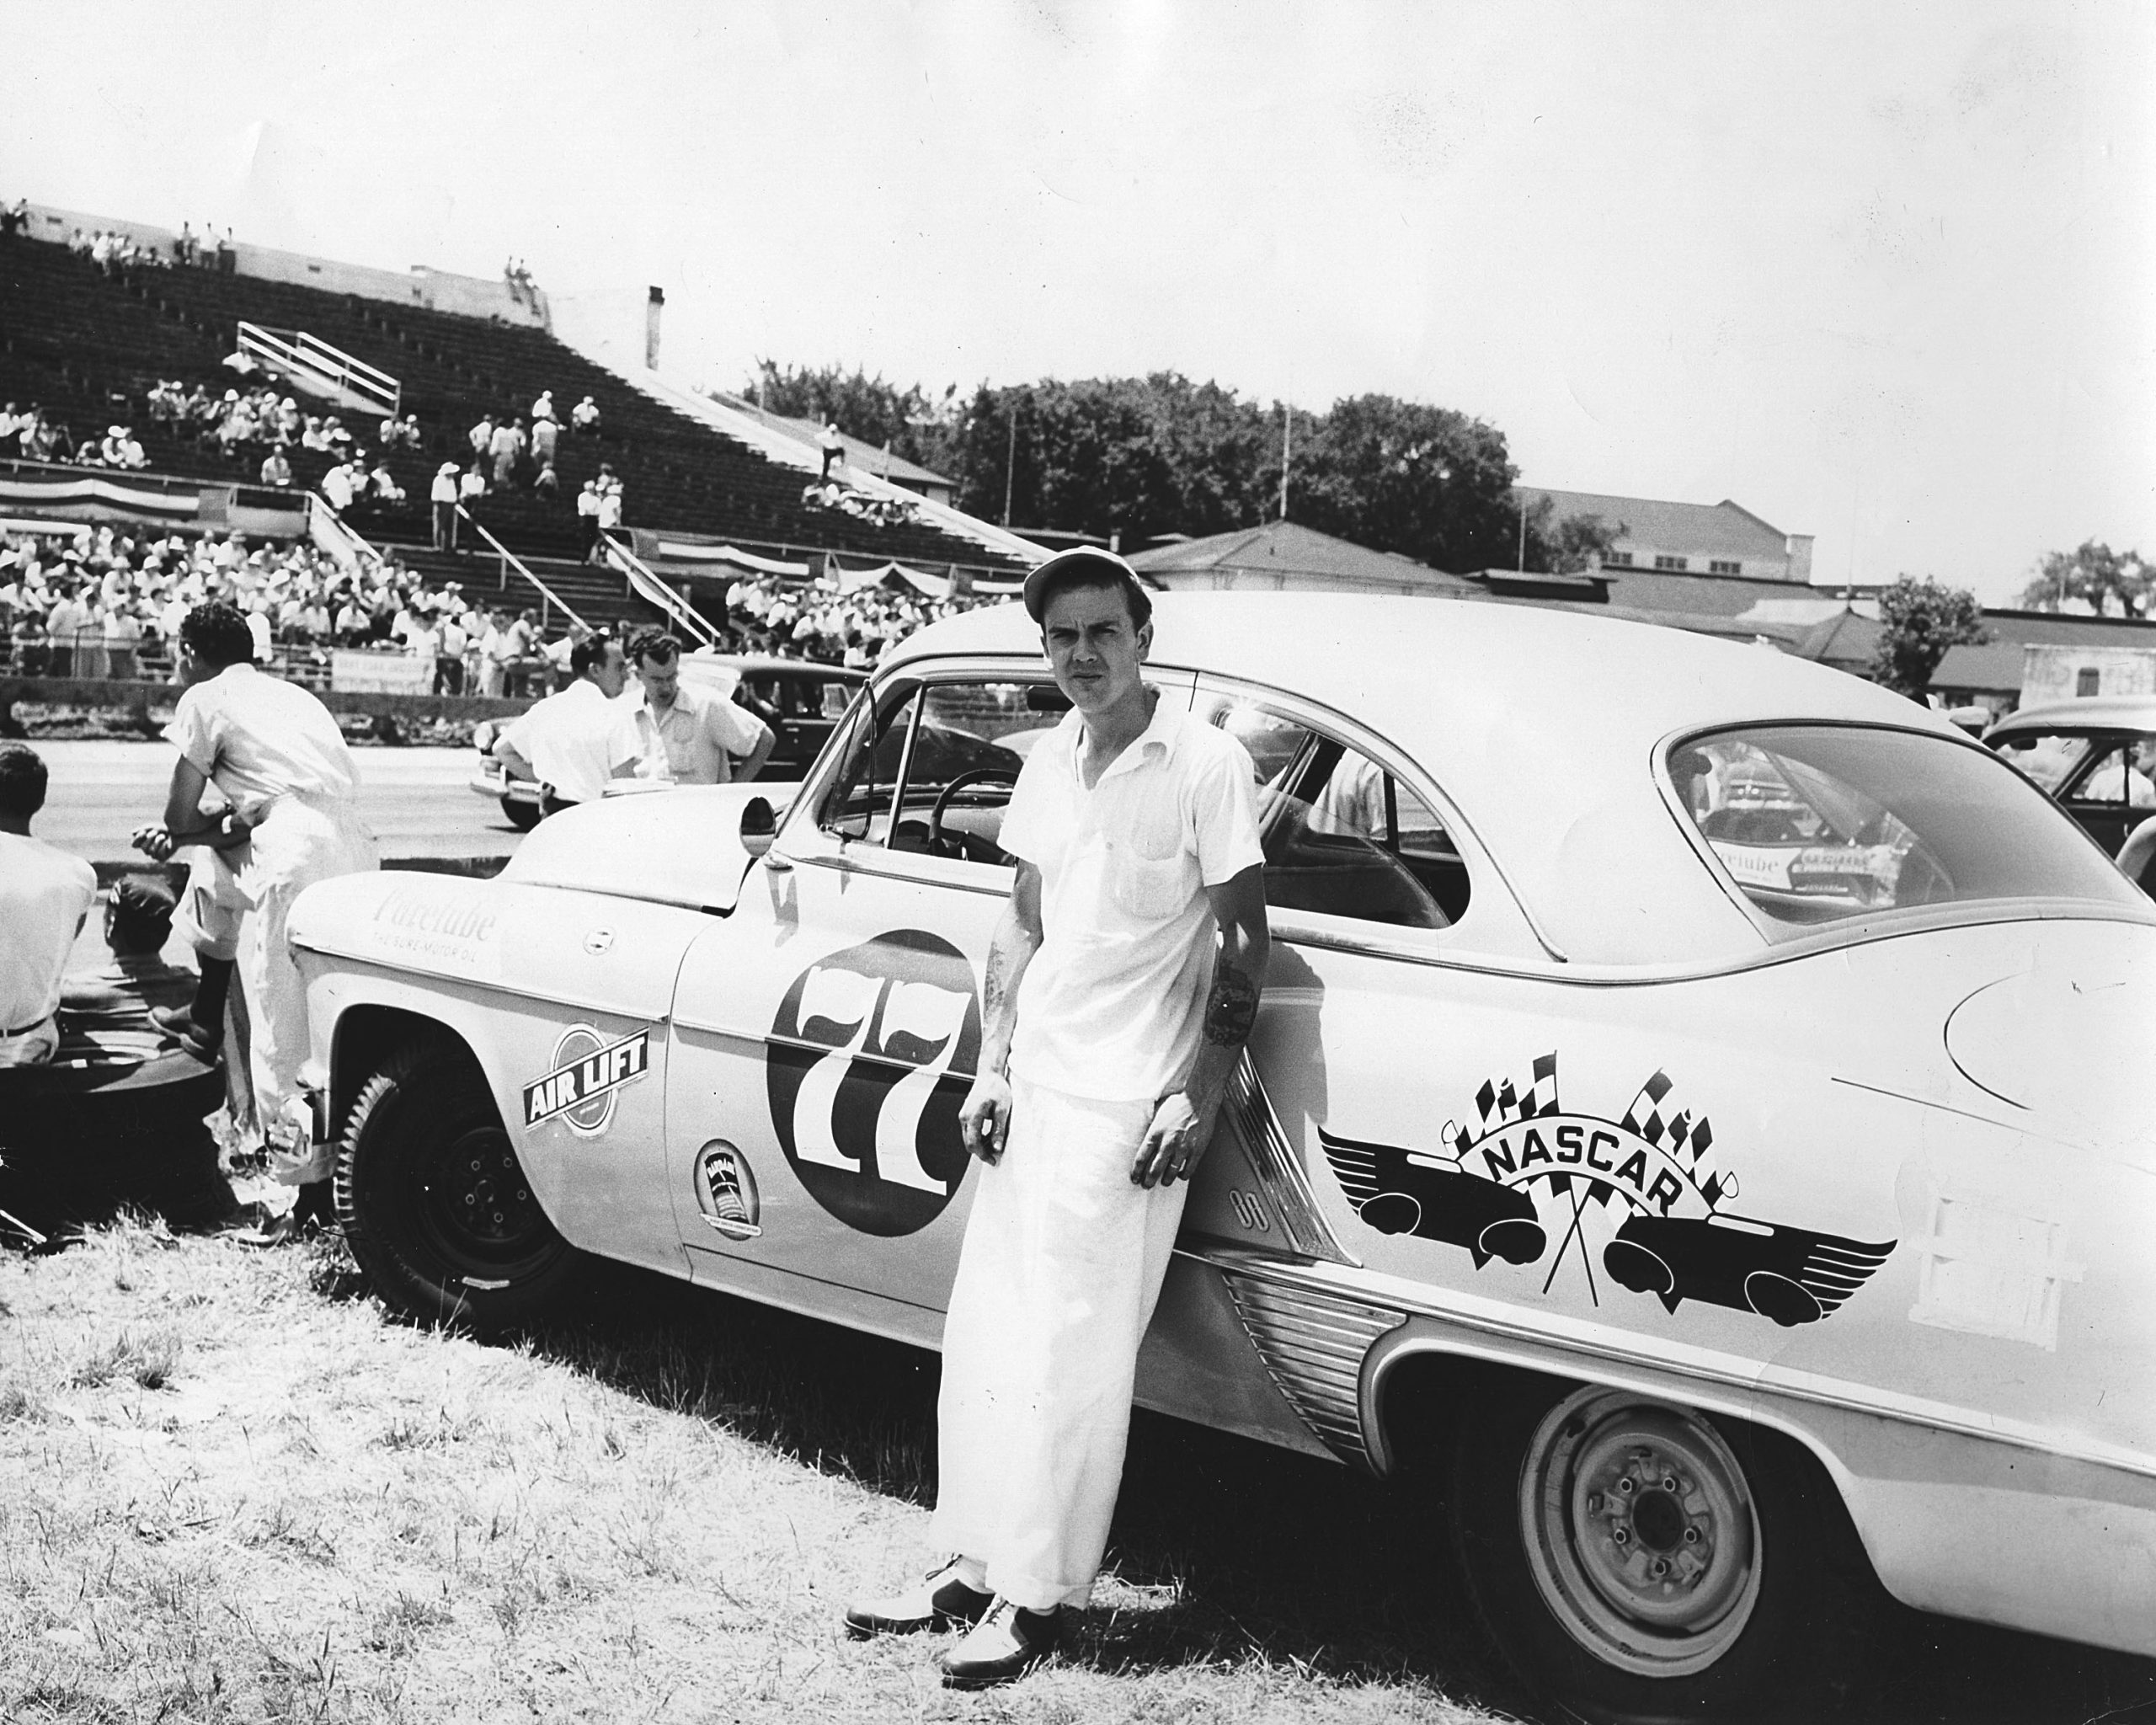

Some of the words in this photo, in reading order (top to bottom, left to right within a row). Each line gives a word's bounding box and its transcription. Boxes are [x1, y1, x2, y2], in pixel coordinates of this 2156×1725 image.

[461, 948, 478, 963] OIL
[531, 1071, 578, 1121] AIR
[583, 1036, 645, 1095] LIFT
[793, 965, 972, 1196] 77
[1230, 1190, 1269, 1231] 88
[1481, 1125, 1683, 1217] NASCAR
